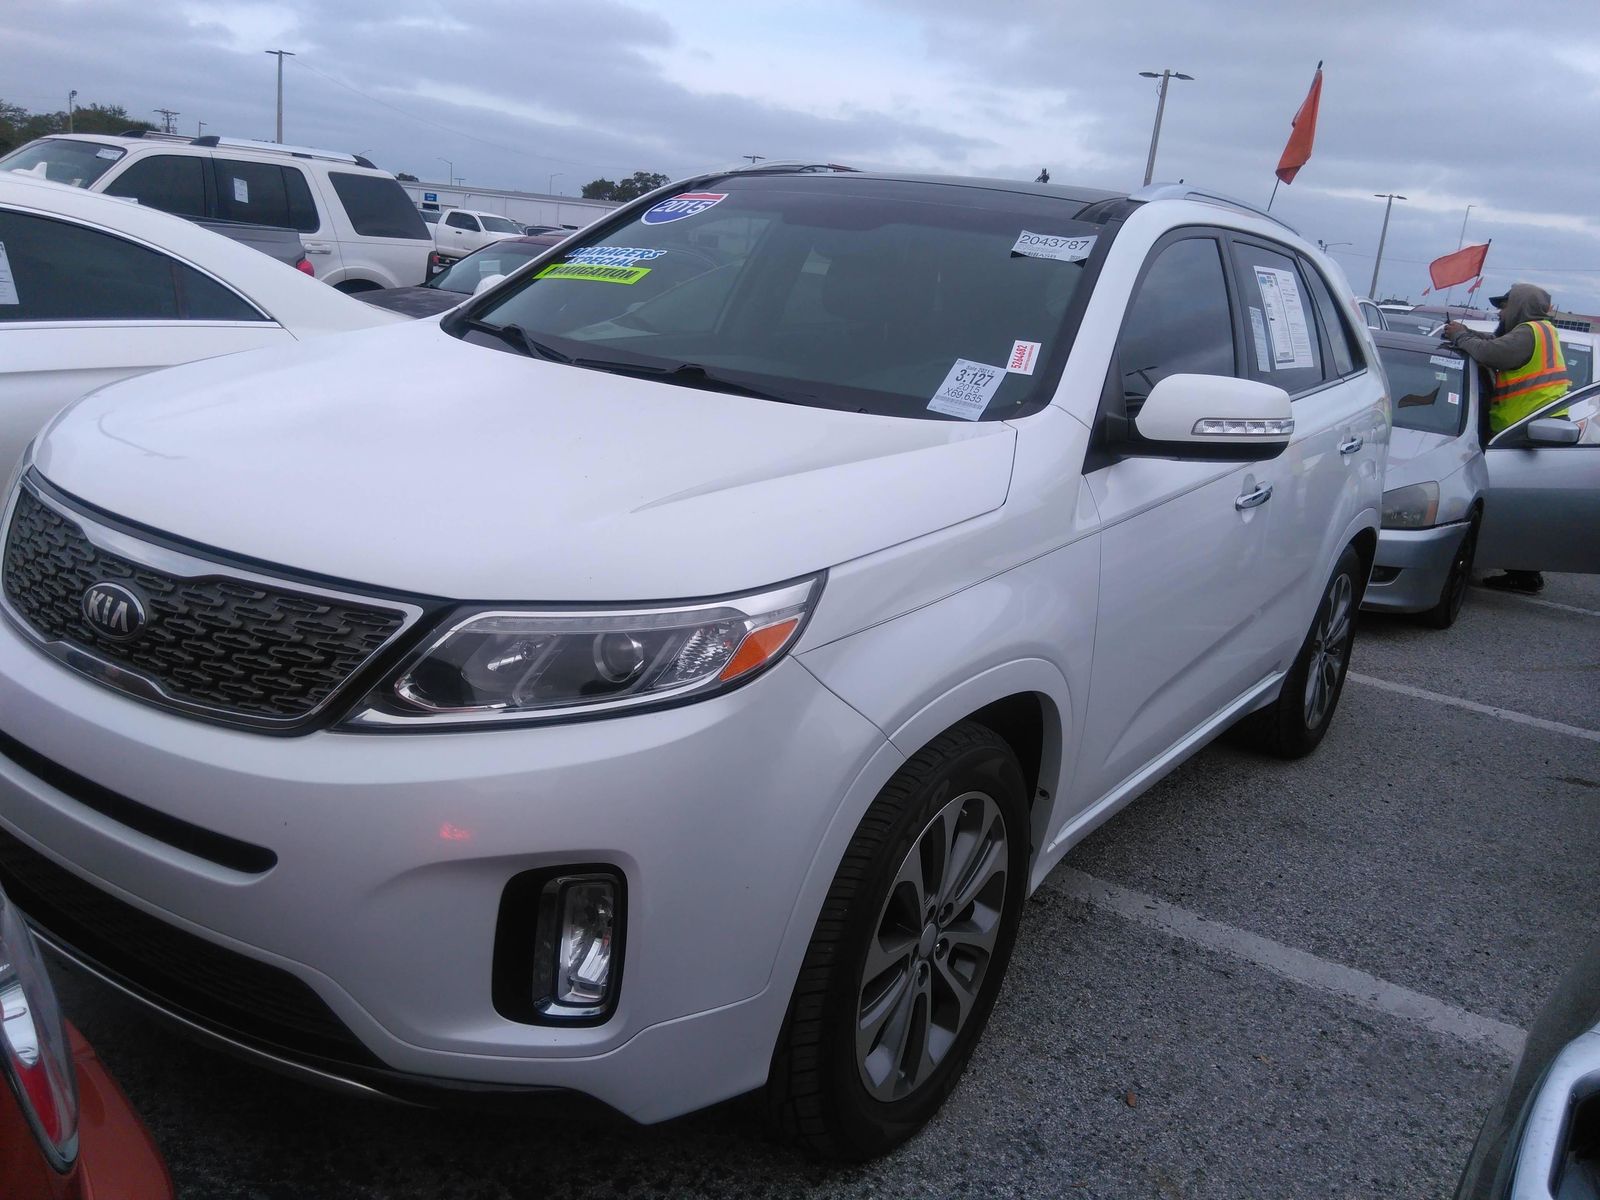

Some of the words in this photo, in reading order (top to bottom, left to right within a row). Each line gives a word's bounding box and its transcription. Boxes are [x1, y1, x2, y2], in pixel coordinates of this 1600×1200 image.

[651, 199, 711, 214] 2015
[1019, 234, 1090, 251] 2043787
[570, 247, 664, 259] MANAGERS
[568, 256, 636, 268] SPECIAL
[544, 265, 638, 280] NAVIGATION
[955, 368, 994, 388] 3:127
[956, 382, 981, 394] 2015
[88, 590, 129, 633] KIA
